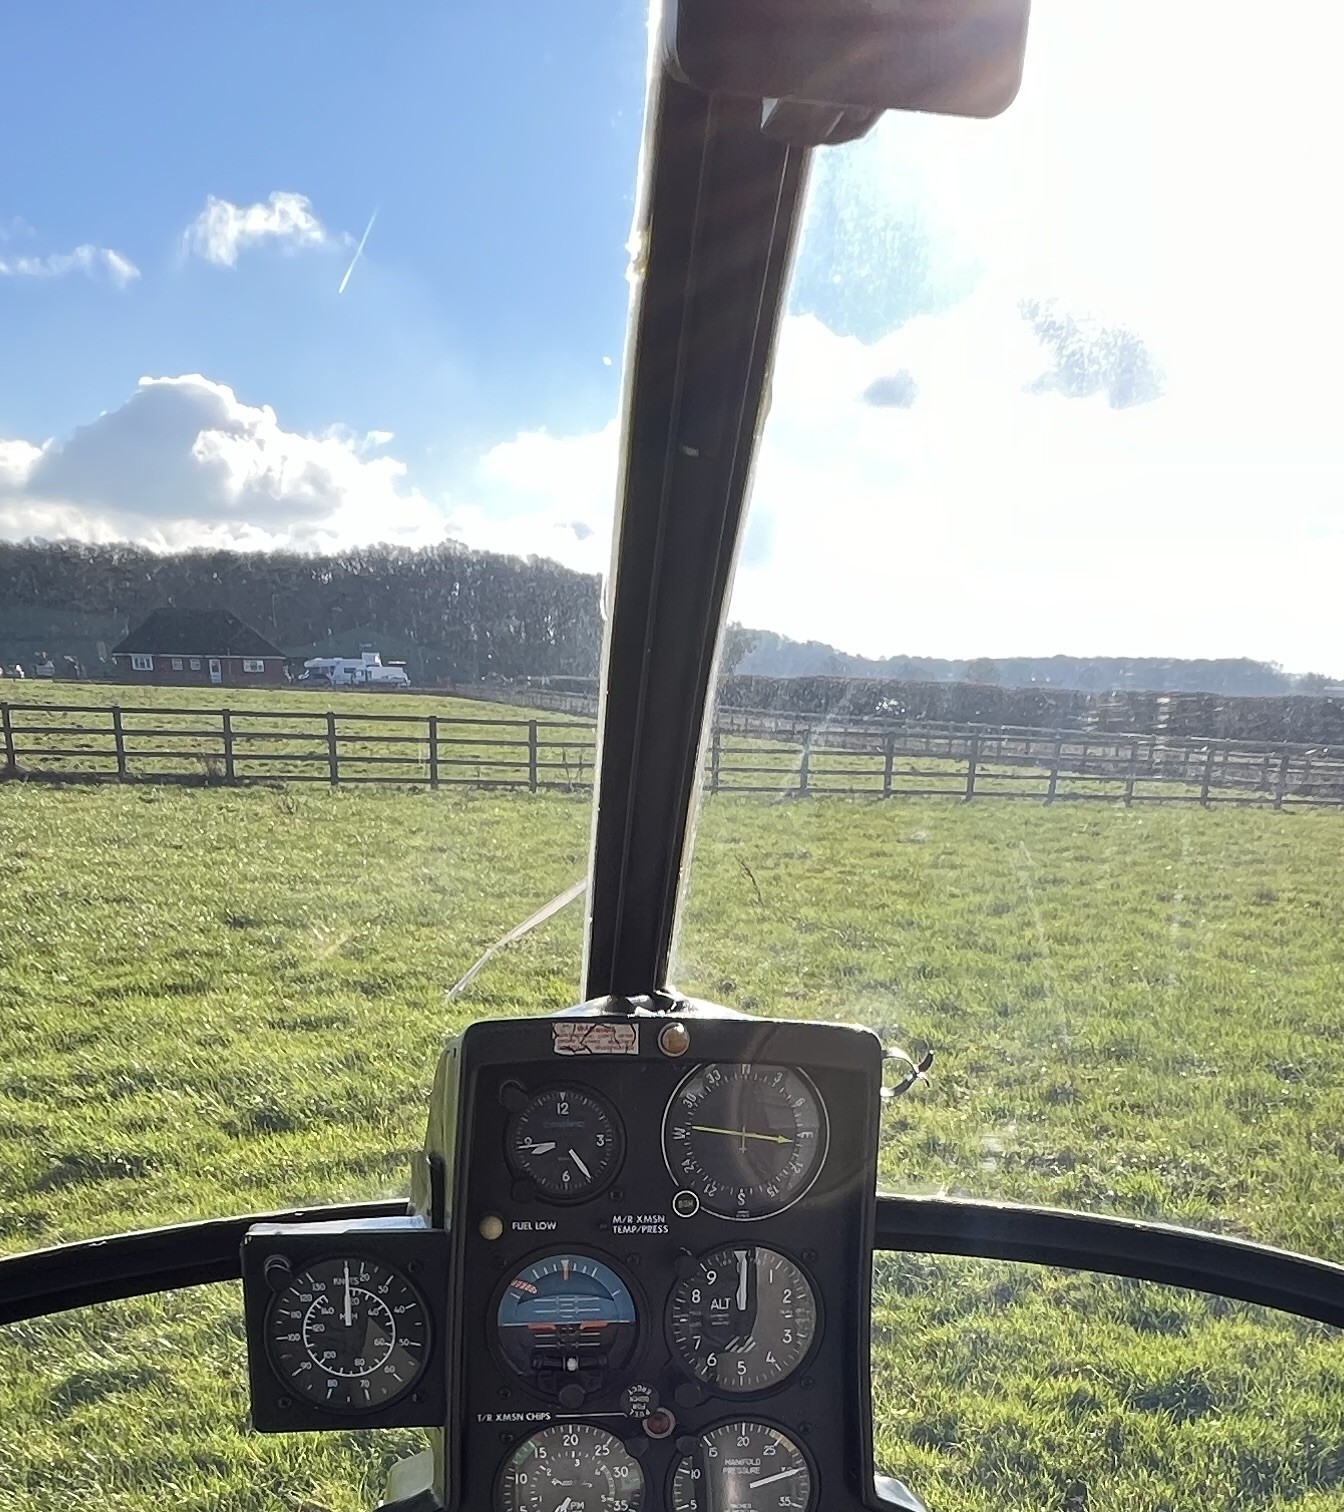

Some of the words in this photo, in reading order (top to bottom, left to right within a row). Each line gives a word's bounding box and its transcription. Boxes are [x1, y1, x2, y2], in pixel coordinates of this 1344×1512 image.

[706, 1069, 721, 1084] 33
[773, 1072, 783, 1084] 3
[682, 1092, 697, 1109] 30
[557, 1102, 569, 1115] 12
[673, 1126, 686, 1140] W
[596, 1134, 605, 1147] 3
[681, 1158, 696, 1174] 24
[562, 1170, 571, 1182] 6
[737, 1191, 746, 1206] S
[612, 1215, 633, 1224] M/R
[636, 1214, 666, 1223] XMSN
[512, 1221, 533, 1230] FUEL
[535, 1221, 557, 1230] LOW
[612, 1224, 669, 1234] TEMP/PRESS
[333, 1277, 359, 1286] KNTS
[360, 1273, 371, 1282] 20
[706, 1270, 717, 1285] 9
[768, 1269, 773, 1284] 1
[692, 1289, 701, 1303] 8
[782, 1289, 792, 1303] 2
[394, 1305, 406, 1313] 40
[710, 1298, 731, 1310] ALT
[373, 1338, 386, 1346] 60
[398, 1338, 410, 1346] 50
[782, 1329, 792, 1343] 3
[692, 1336, 702, 1350] 7
[706, 1352, 718, 1366] 6
[766, 1351, 777, 1363] 4
[300, 1362, 312, 1370] 90
[384, 1365, 395, 1373] 60
[737, 1361, 747, 1375] 5
[359, 1379, 370, 1388] 70
[477, 1413, 492, 1422] T/R
[495, 1412, 524, 1422] XMSN
[526, 1411, 551, 1421] CHIPS
[562, 1433, 579, 1446] 20
[737, 1437, 750, 1447] 20
[534, 1447, 547, 1459] 15
[595, 1444, 610, 1456] 25
[708, 1447, 718, 1457] 15
[763, 1445, 777, 1456] 25
[574, 1458, 581, 1467] 3
[724, 1458, 761, 1466] MANIFOLD
[546, 1468, 552, 1476] 2
[613, 1466, 629, 1478] 30
[690, 1469, 701, 1479] 10
[722, 1467, 760, 1475] PRESSURE
[515, 1473, 528, 1485] 10
[600, 1494, 607, 1502] 5
[778, 1497, 791, 1507] 35
[613, 1500, 629, 1512] 35
[690, 1500, 697, 1510] 5
